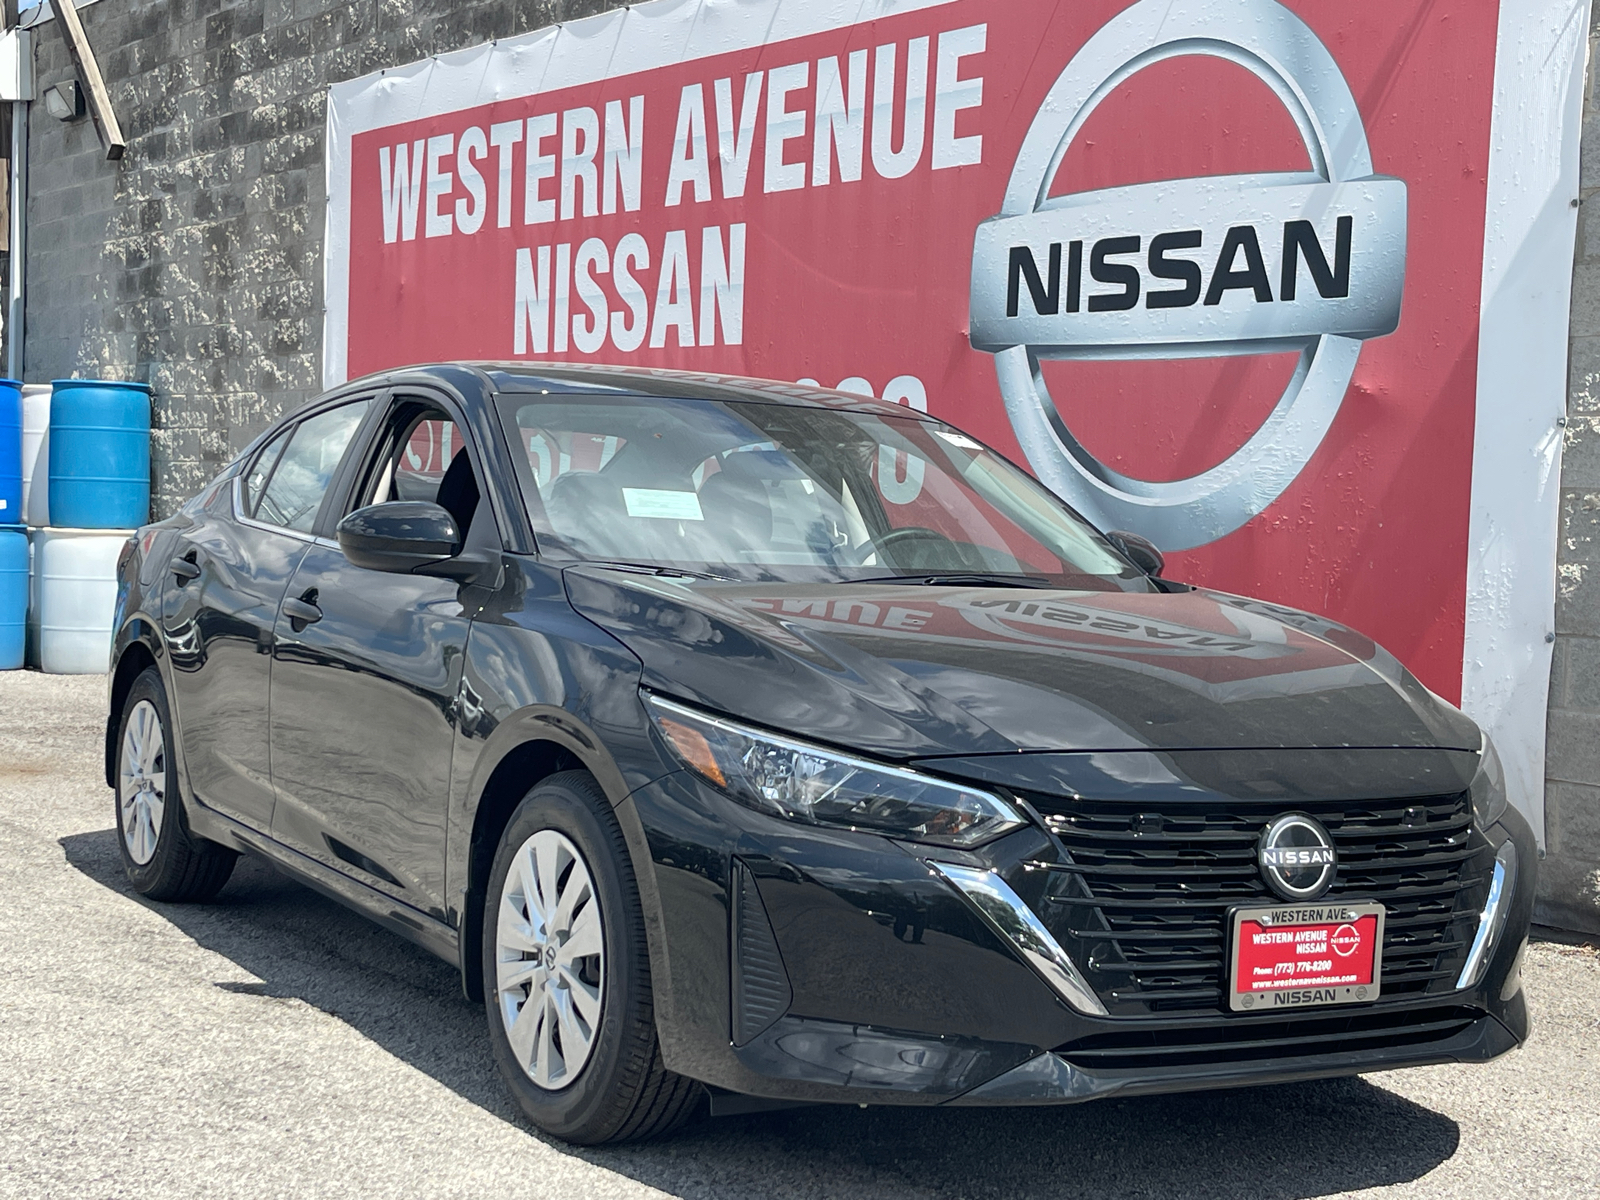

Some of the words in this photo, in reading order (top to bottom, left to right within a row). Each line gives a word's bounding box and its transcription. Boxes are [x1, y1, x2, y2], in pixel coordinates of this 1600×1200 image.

[379, 94, 645, 244] WESTERN
[664, 23, 988, 208] AVENUE
[1006, 214, 1354, 318] NISSAN
[513, 222, 747, 355] NISSAN
[1263, 850, 1334, 864] NISSAN
[1271, 909, 1324, 923] WESTERN
[1253, 932, 1293, 944] WESTERN
[1295, 930, 1327, 942] AVENUE
[1330, 936, 1361, 944] NISSAN
[1296, 943, 1327, 954] NISSAN
[1274, 962, 1295, 976] (773)
[1274, 989, 1336, 1005] NISSAN
